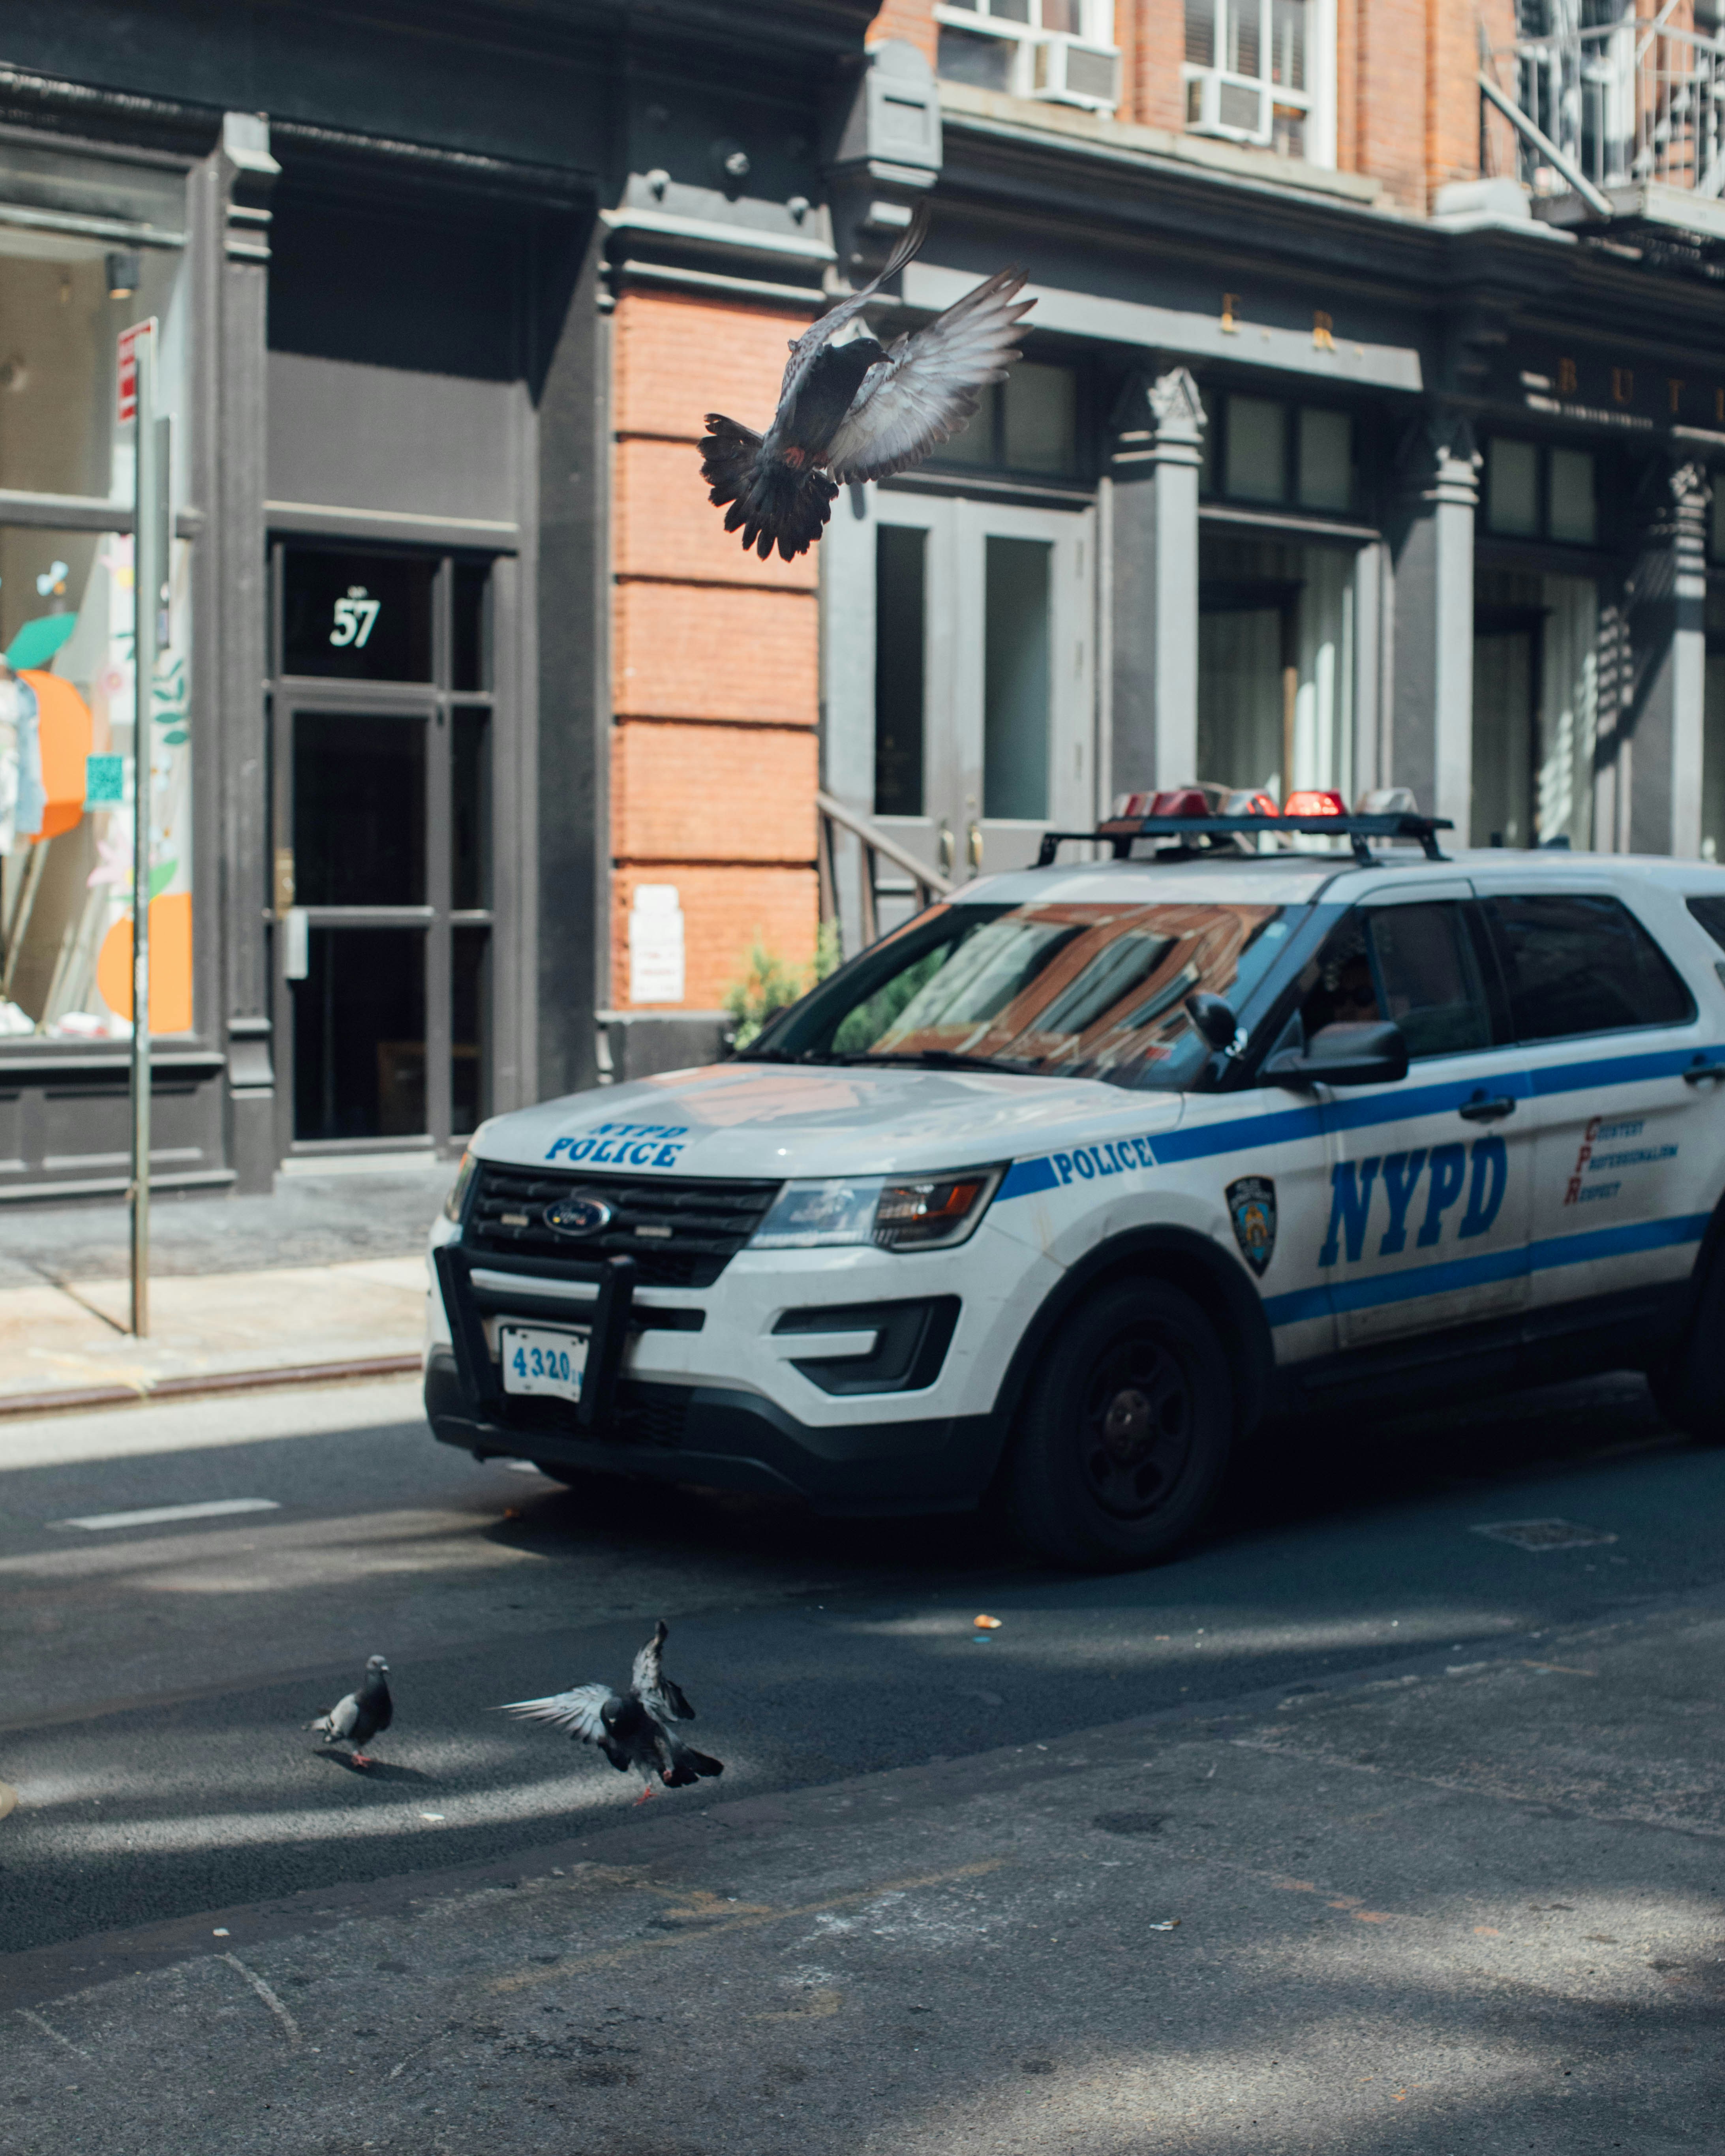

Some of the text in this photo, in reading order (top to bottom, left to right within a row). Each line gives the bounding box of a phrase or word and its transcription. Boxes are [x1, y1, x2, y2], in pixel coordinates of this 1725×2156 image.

[329, 597, 381, 648] 57
[589, 1123, 689, 1138] NYPD
[545, 1137, 685, 1167] POLICE
[1053, 1138, 1153, 1184] POLICE
[1318, 1135, 1507, 1267] NYPD
[513, 1347, 570, 1381] 4320
